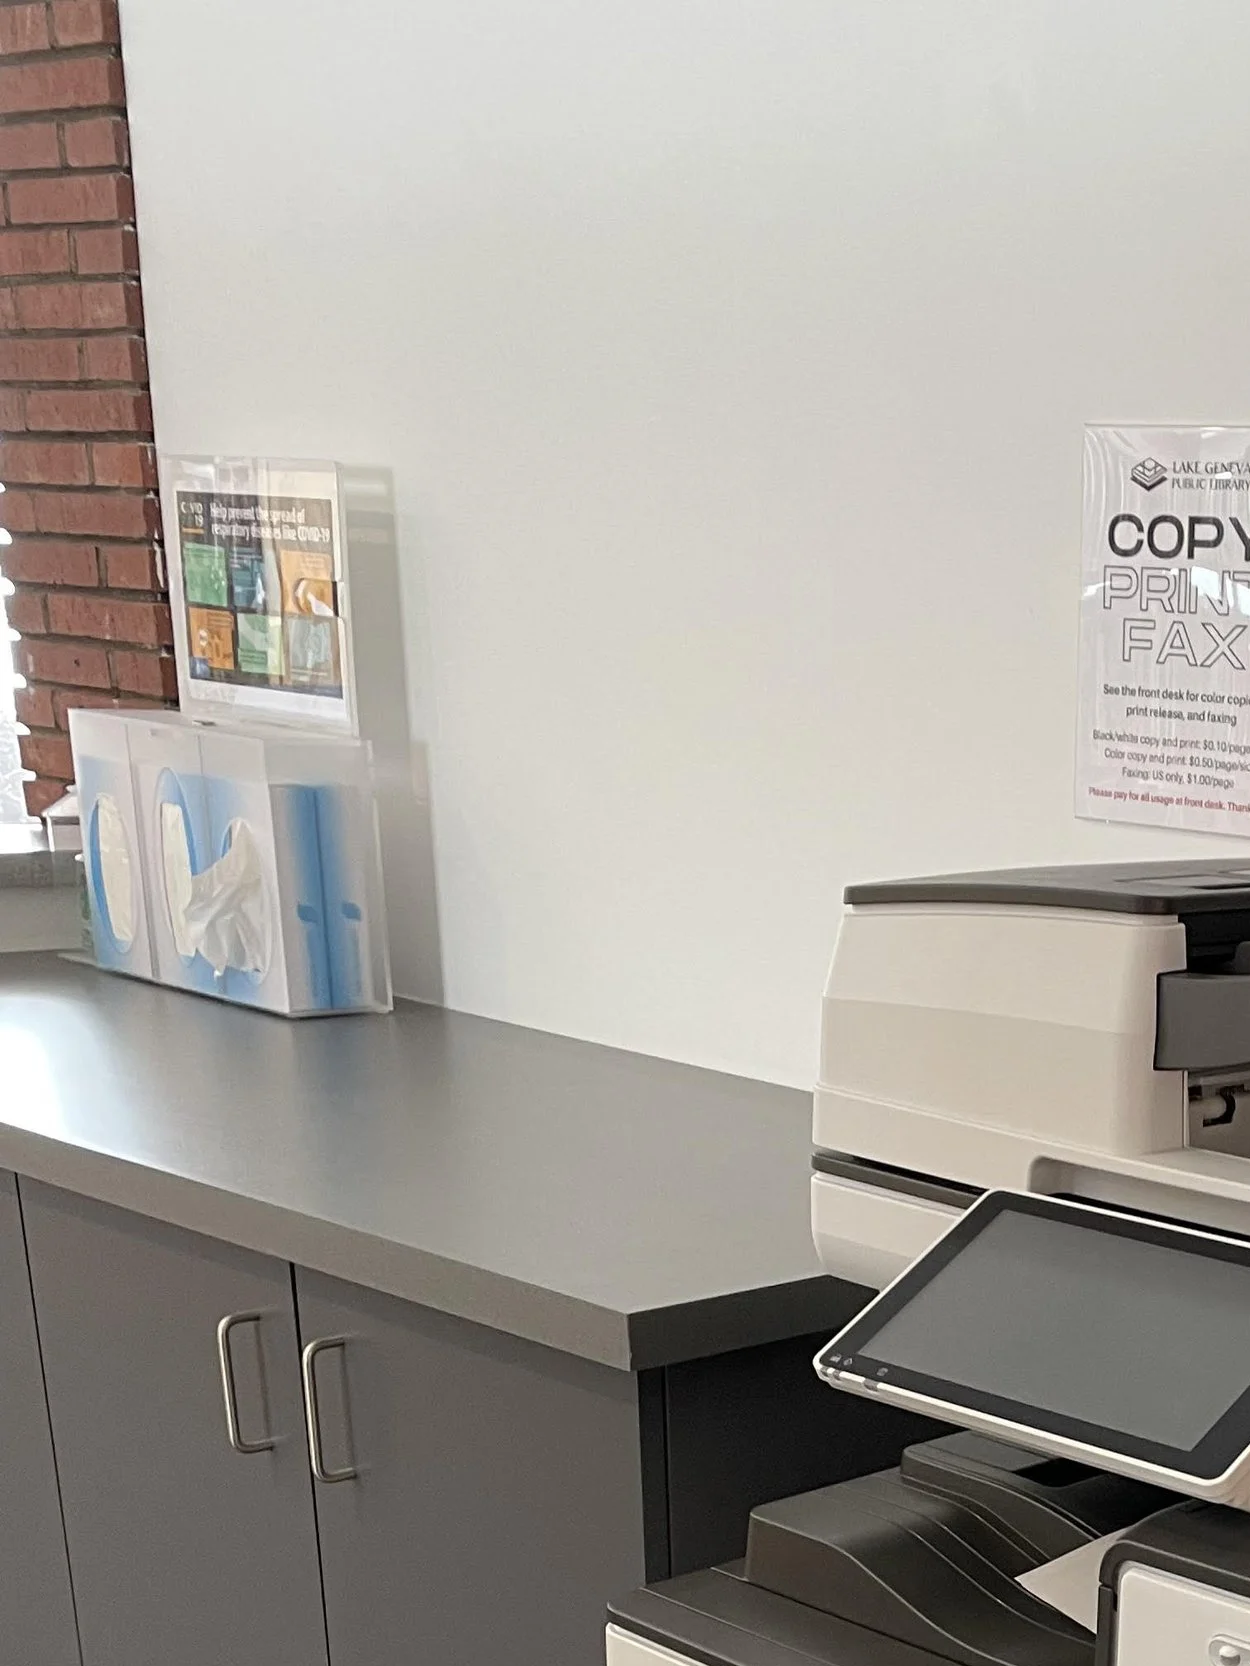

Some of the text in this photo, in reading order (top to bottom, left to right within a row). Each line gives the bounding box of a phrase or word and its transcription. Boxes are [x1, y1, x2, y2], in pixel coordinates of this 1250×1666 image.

[1172, 461, 1201, 474] LAKE
[1171, 477, 1250, 492] PUBLIC LIBRARY
[1122, 618, 1248, 670] FAX
[1103, 684, 1120, 695] See
[1121, 685, 1137, 697] the
[1138, 686, 1160, 699] front
[1162, 689, 1184, 701] desk
[1186, 690, 1199, 702] for
[1200, 692, 1225, 704] color
[1126, 706, 1237, 727] print release, and faxing
[1092, 729, 1139, 744] Black/white
[1140, 736, 1160, 748] copy
[1161, 737, 1178, 747] and
[1104, 748, 1125, 759] Color
[1127, 752, 1148, 763] copy
[1149, 753, 1165, 764] and
[1152, 769, 1164, 781] US
[1088, 786, 1113, 798] Please
[1113, 791, 1128, 802] pay
[1128, 790, 1140, 801] for
[1141, 793, 1150, 802] all
[1150, 795, 1175, 806] usage
[1176, 798, 1183, 806] at
[1184, 797, 1203, 809] front
